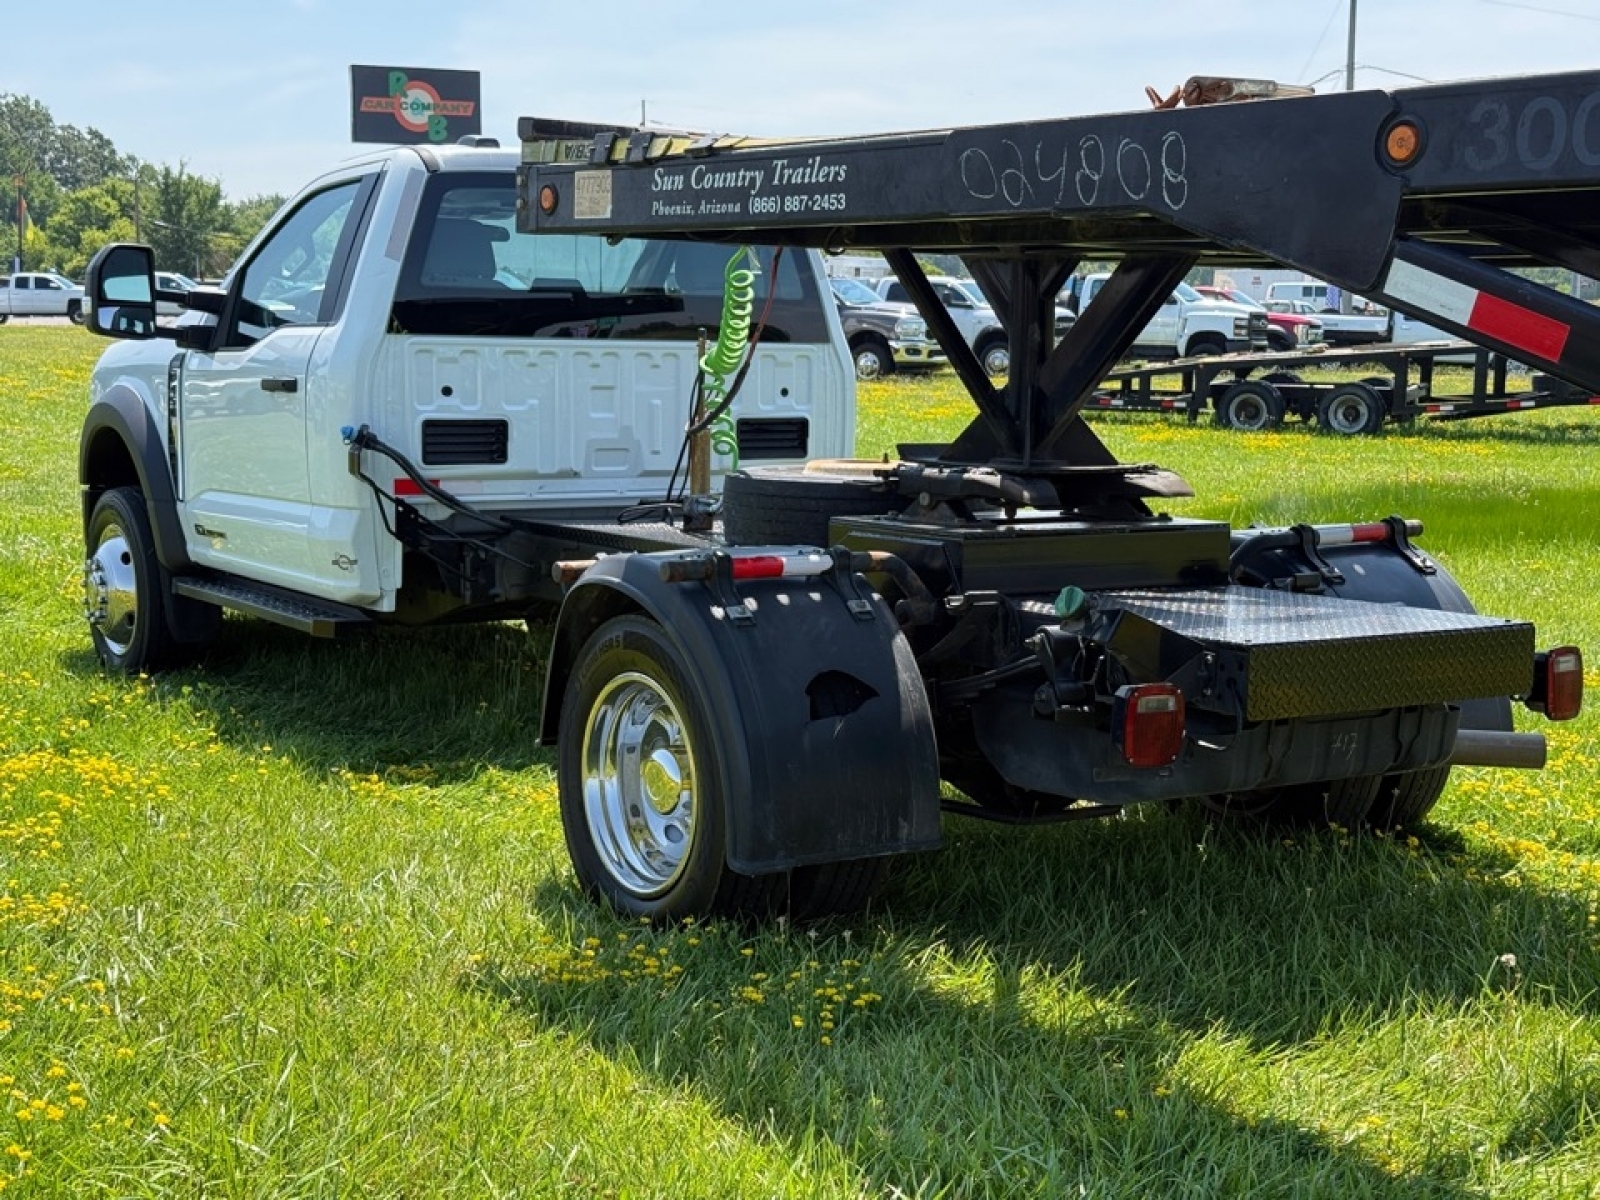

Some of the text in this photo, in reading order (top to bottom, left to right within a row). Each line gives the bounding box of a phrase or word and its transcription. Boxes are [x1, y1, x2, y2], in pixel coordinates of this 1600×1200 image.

[388, 70, 409, 99] R
[364, 99, 471, 114] CAR COMPANY
[428, 115, 448, 142] B
[651, 156, 848, 195] Sun Country Trailers
[651, 200, 696, 216] Phoenix,
[698, 198, 741, 214] Arizona
[748, 195, 781, 214] (866)
